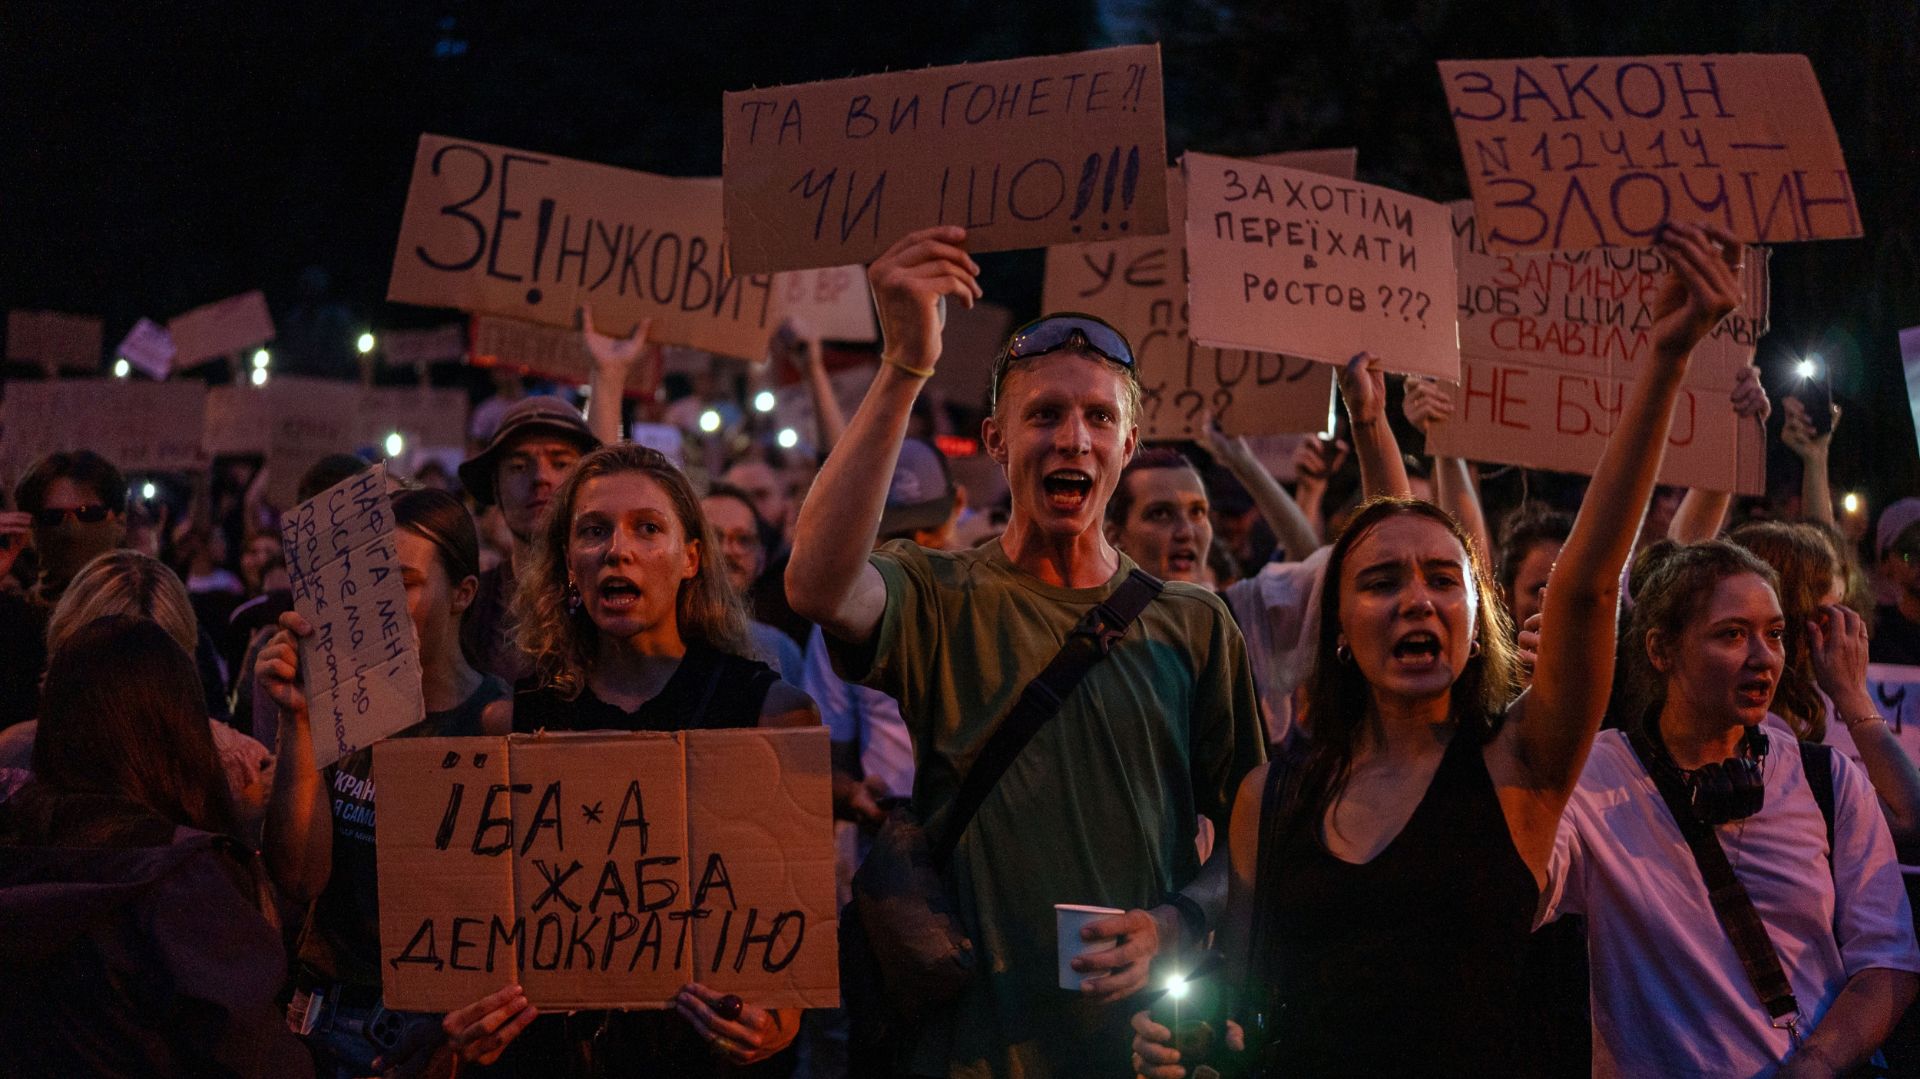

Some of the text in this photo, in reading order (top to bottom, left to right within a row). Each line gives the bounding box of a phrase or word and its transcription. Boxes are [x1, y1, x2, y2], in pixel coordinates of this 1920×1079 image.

[741, 101, 803, 145] ТА
[1454, 62, 1735, 123] ЗАКОН
[790, 166, 887, 245] ЧИ
[1486, 169, 1860, 247] ЗЛОЧИН
[1214, 211, 1417, 272] ПЕРЕЇХАТИ
[1244, 272, 1431, 330] РОСТОВ???
[1464, 365, 1696, 446] НЕ БУО
[351, 473, 390, 587] НАФІГА
[315, 622, 339, 702] проти
[351, 664, 370, 715] що
[531, 852, 739, 914] ЖАБА
[390, 908, 805, 974] ДЕМОКРАТІЮ
